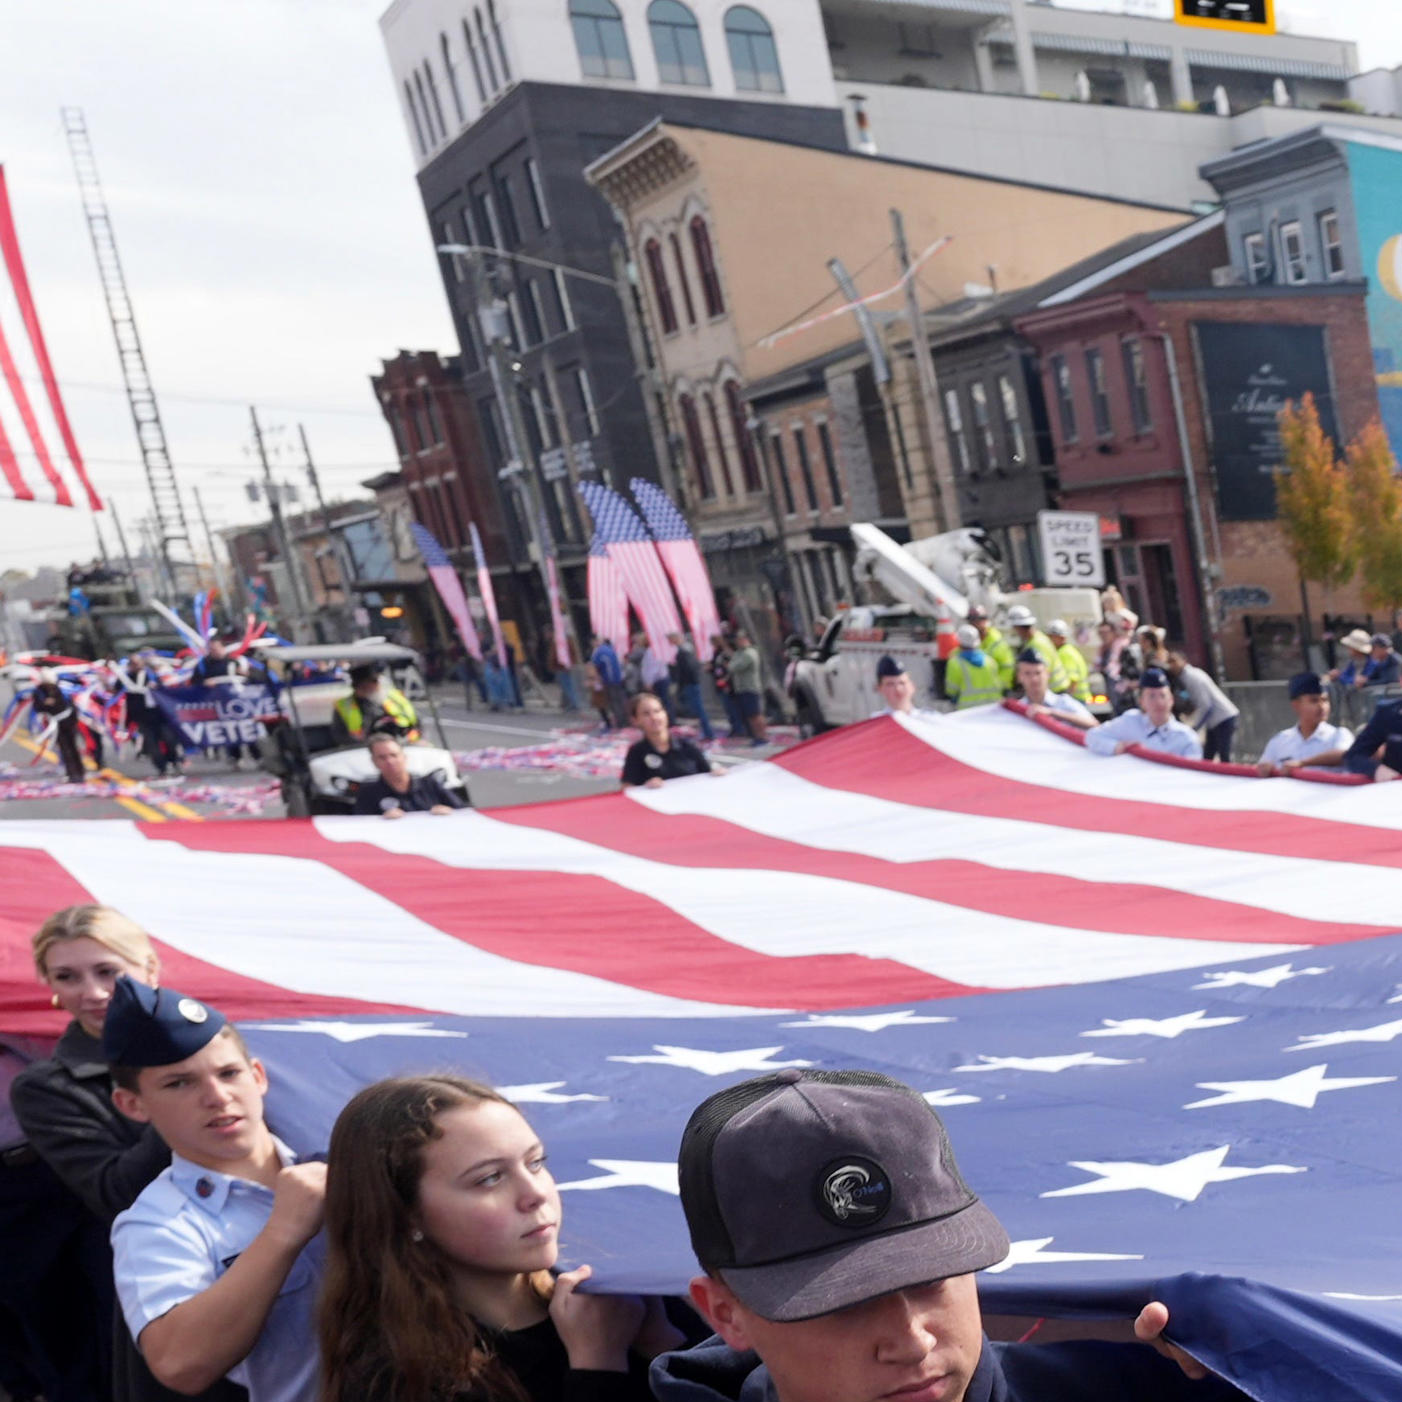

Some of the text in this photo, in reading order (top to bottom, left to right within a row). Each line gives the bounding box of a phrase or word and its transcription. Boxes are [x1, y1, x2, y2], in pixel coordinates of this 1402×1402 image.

[1046, 520, 1094, 533] SPEED
[1051, 535, 1089, 547] LIMIT
[1054, 551, 1094, 576] 35
[215, 697, 276, 719] LOVE
[181, 720, 267, 744] VETE
